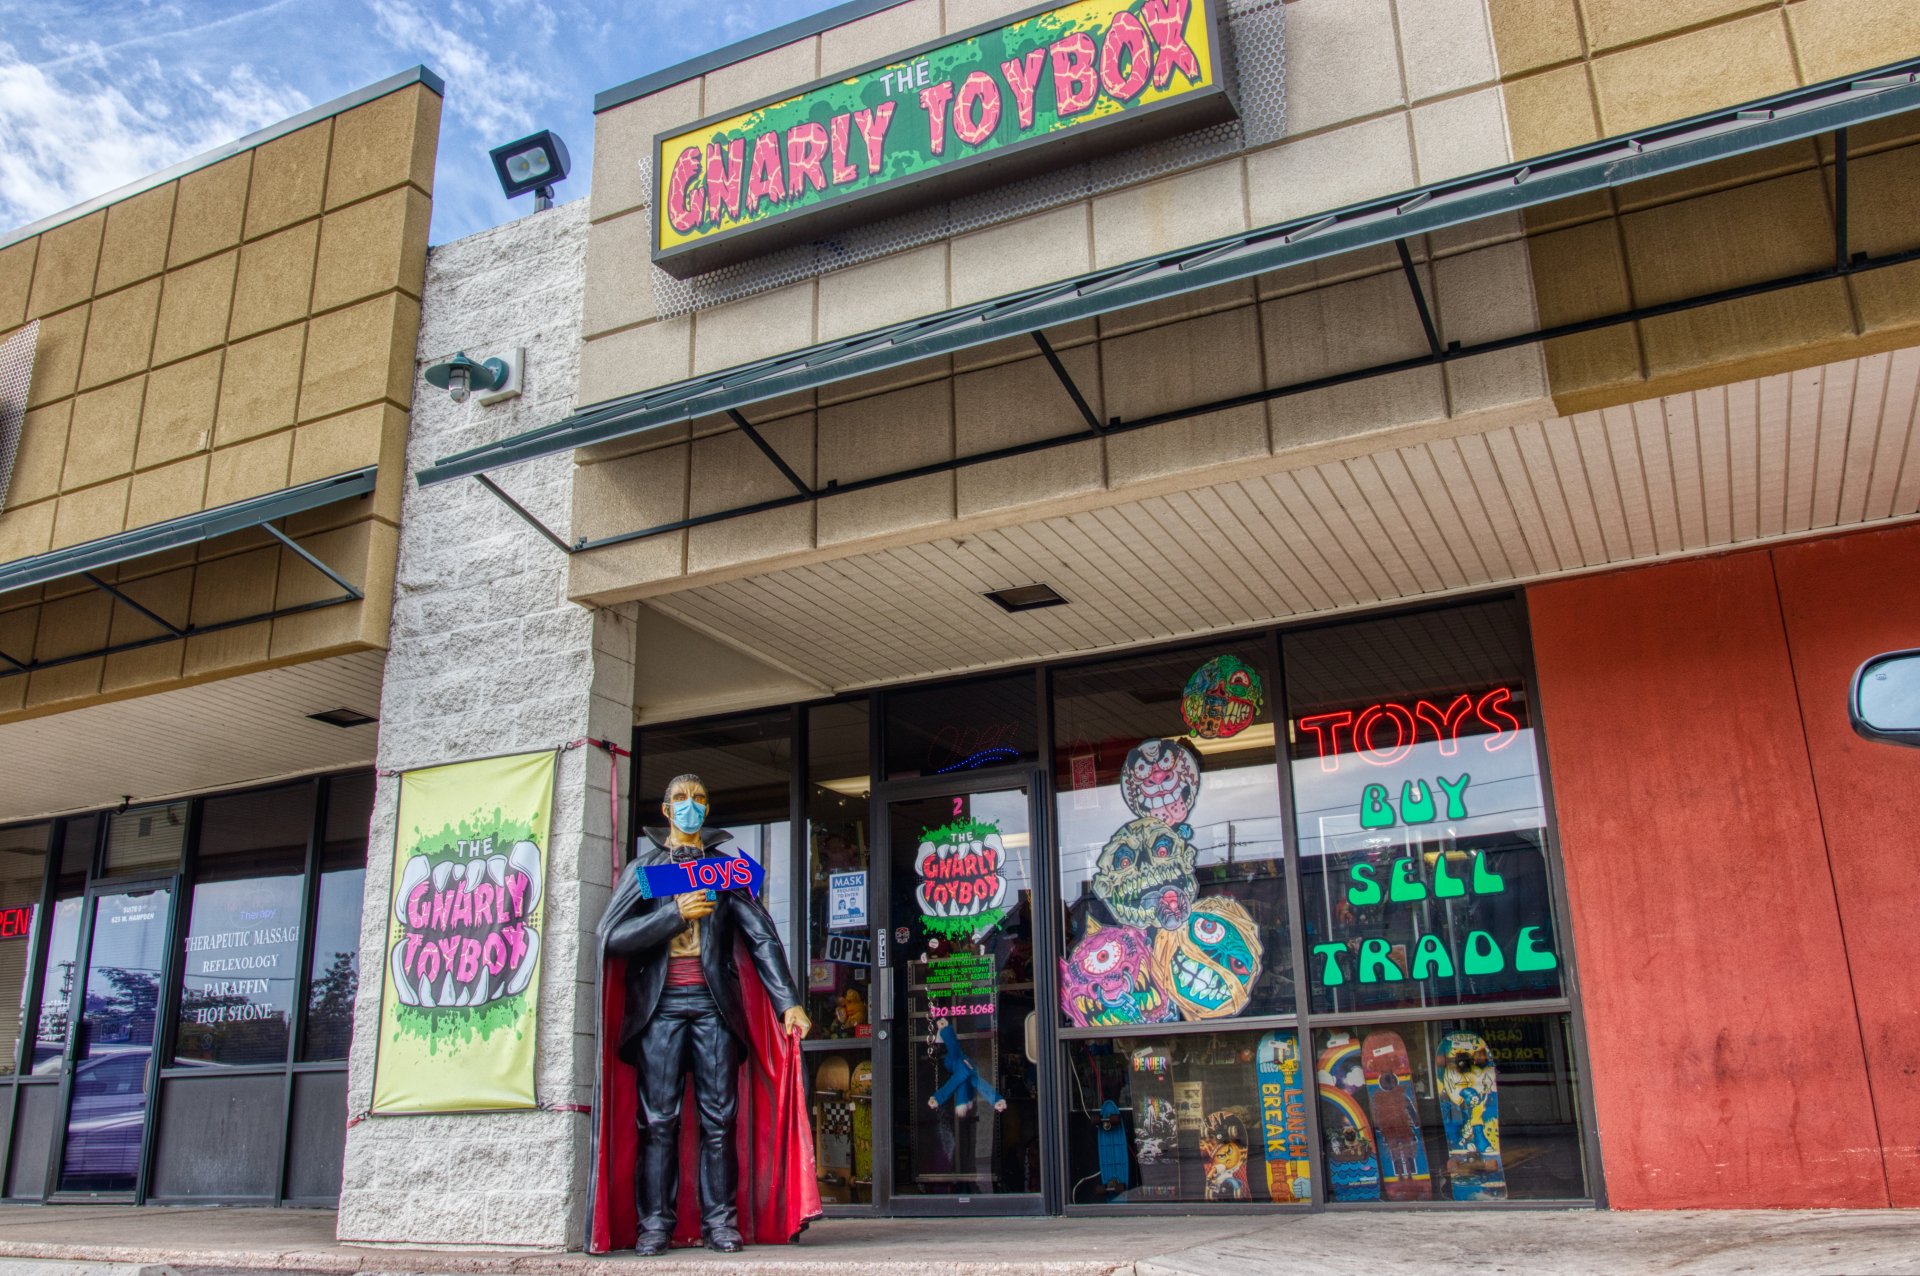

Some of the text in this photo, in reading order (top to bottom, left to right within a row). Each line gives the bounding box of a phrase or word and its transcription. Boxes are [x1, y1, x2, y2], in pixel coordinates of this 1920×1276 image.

[880, 61, 930, 97] THE
[667, 0, 1203, 237] GNARLY TOYBOX
[1300, 688, 1519, 772] TOYS
[952, 797, 963, 816] 2
[1360, 772, 1471, 830] BUY
[457, 837, 494, 859] THE
[951, 832, 973, 842] THE
[923, 848, 997, 879] GNARLY
[834, 875, 862, 887] MASK
[923, 873, 999, 905] TOYBOX
[1347, 849, 1505, 906] SELL
[407, 870, 532, 930] GNARLY
[129, 912, 155, 921] HAMPDEN
[240, 908, 277, 921] Therapy
[184, 931, 250, 952] THERAPEUTIC
[403, 922, 529, 984] TOYBOX
[829, 937, 871, 963] OPEN
[202, 954, 279, 973] REFLEXOLOGY
[1313, 925, 1558, 987] TRADE
[203, 979, 269, 998] PARAFFIN
[196, 1003, 273, 1024] HOT STONE
[950, 1005, 967, 1016] 355
[969, 1003, 994, 1015] 1068
[1133, 1056, 1167, 1072] BEAVER
[1262, 1083, 1286, 1153] BREAK
[1283, 1089, 1308, 1157] LUNCH
